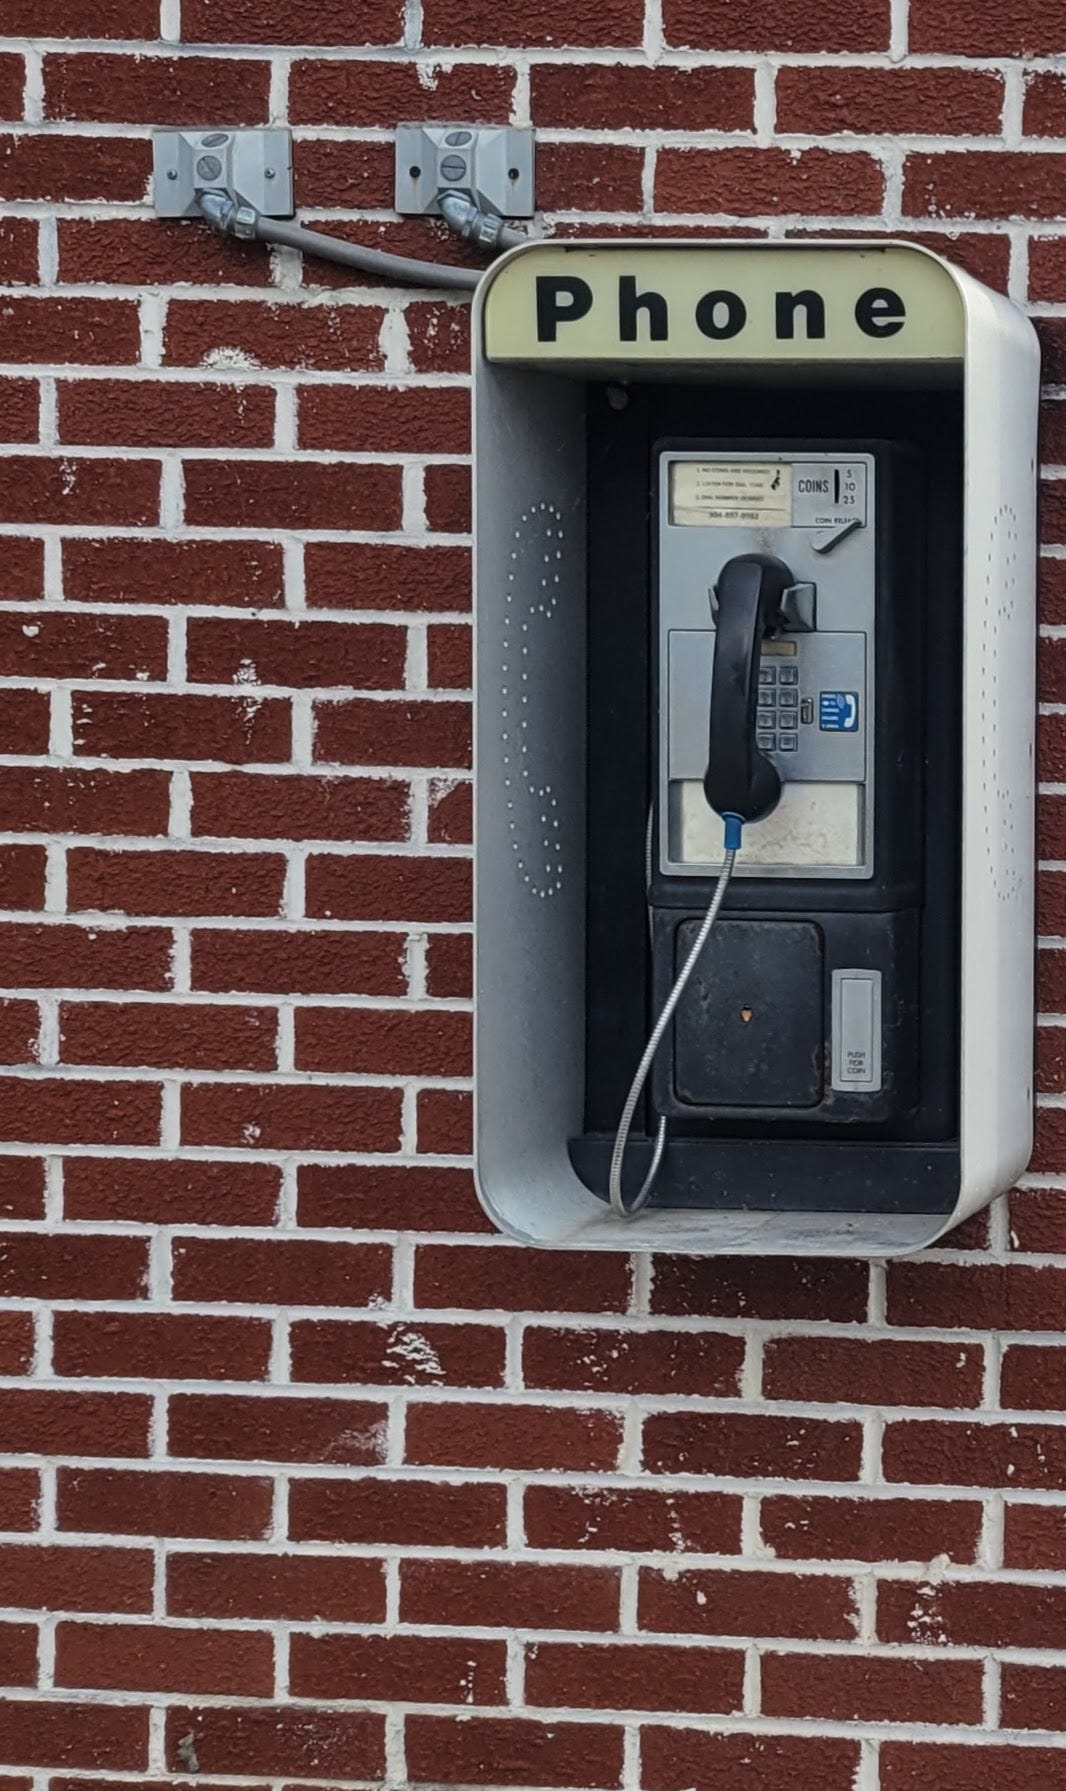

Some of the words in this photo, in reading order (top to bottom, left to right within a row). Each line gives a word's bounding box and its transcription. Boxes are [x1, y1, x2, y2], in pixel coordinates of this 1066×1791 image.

[535, 275, 906, 342] Phone
[846, 469, 852, 478] 5
[798, 479, 829, 493] COINS
[844, 482, 856, 491] 10
[843, 495, 855, 504] 25
[815, 516, 832, 524] COIN
